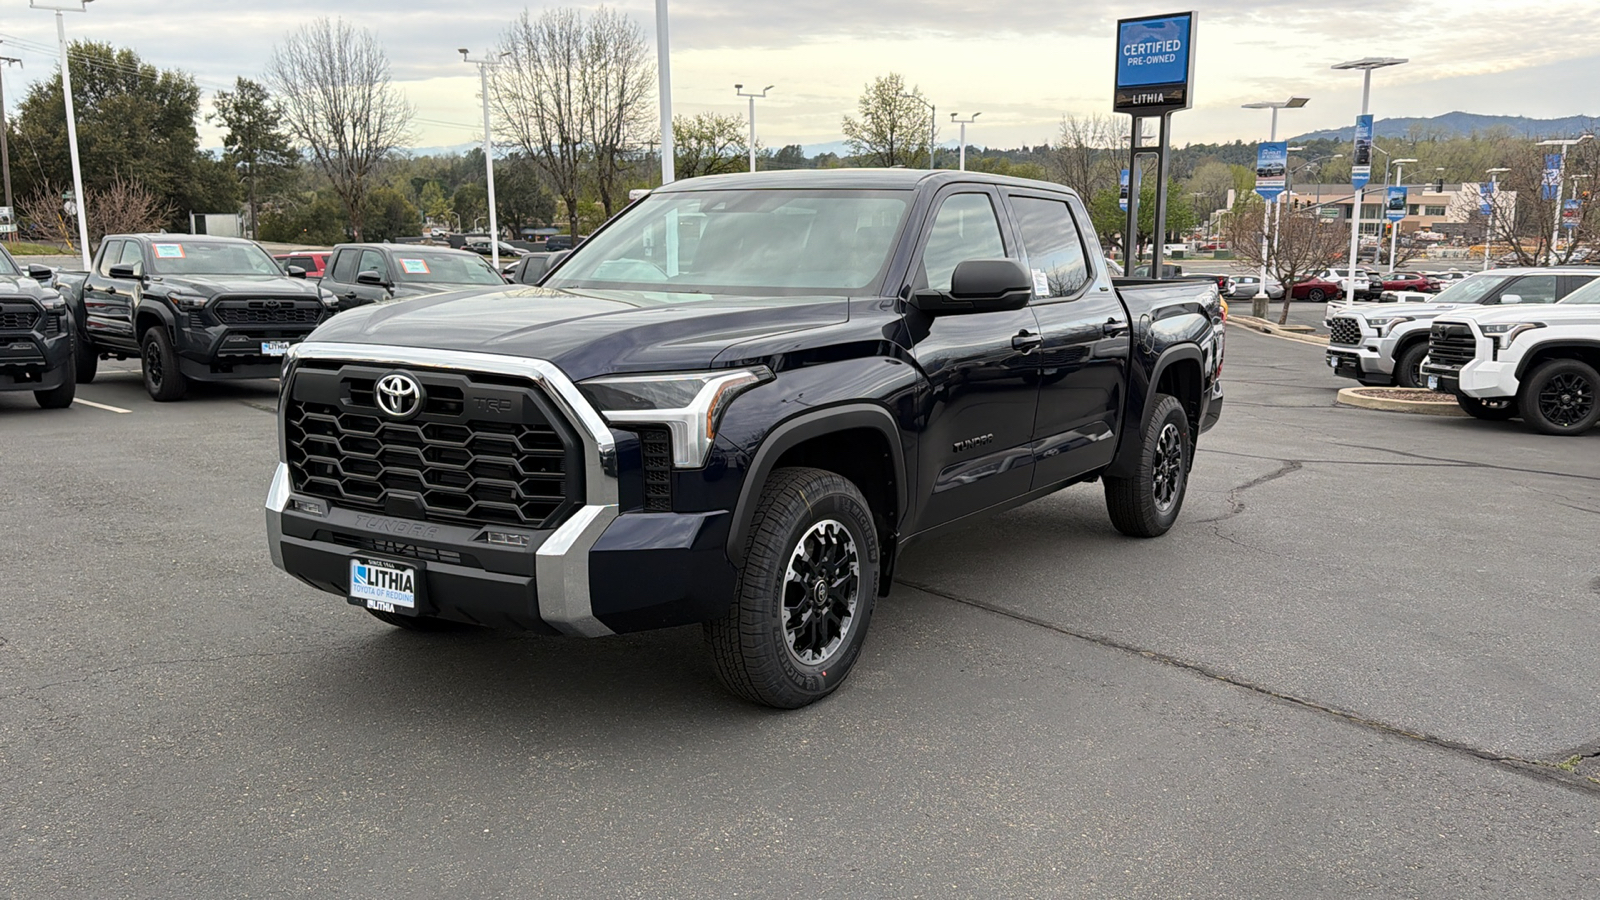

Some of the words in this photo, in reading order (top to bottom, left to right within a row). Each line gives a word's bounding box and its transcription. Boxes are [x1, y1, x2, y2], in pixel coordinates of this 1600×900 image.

[1123, 40, 1181, 56] CERTIFIED
[1127, 54, 1176, 66] PRE-OWNED
[1132, 93, 1164, 104] LITHIA
[473, 396, 512, 413] TRD
[953, 433, 993, 452] TUNDRA
[355, 514, 438, 538] TUNDRA
[368, 568, 413, 593] LITHIA
[353, 584, 376, 595] TOYOTA
[376, 588, 384, 597] OF
[385, 590, 414, 603] REDDING
[374, 600, 395, 613] LITHIA
